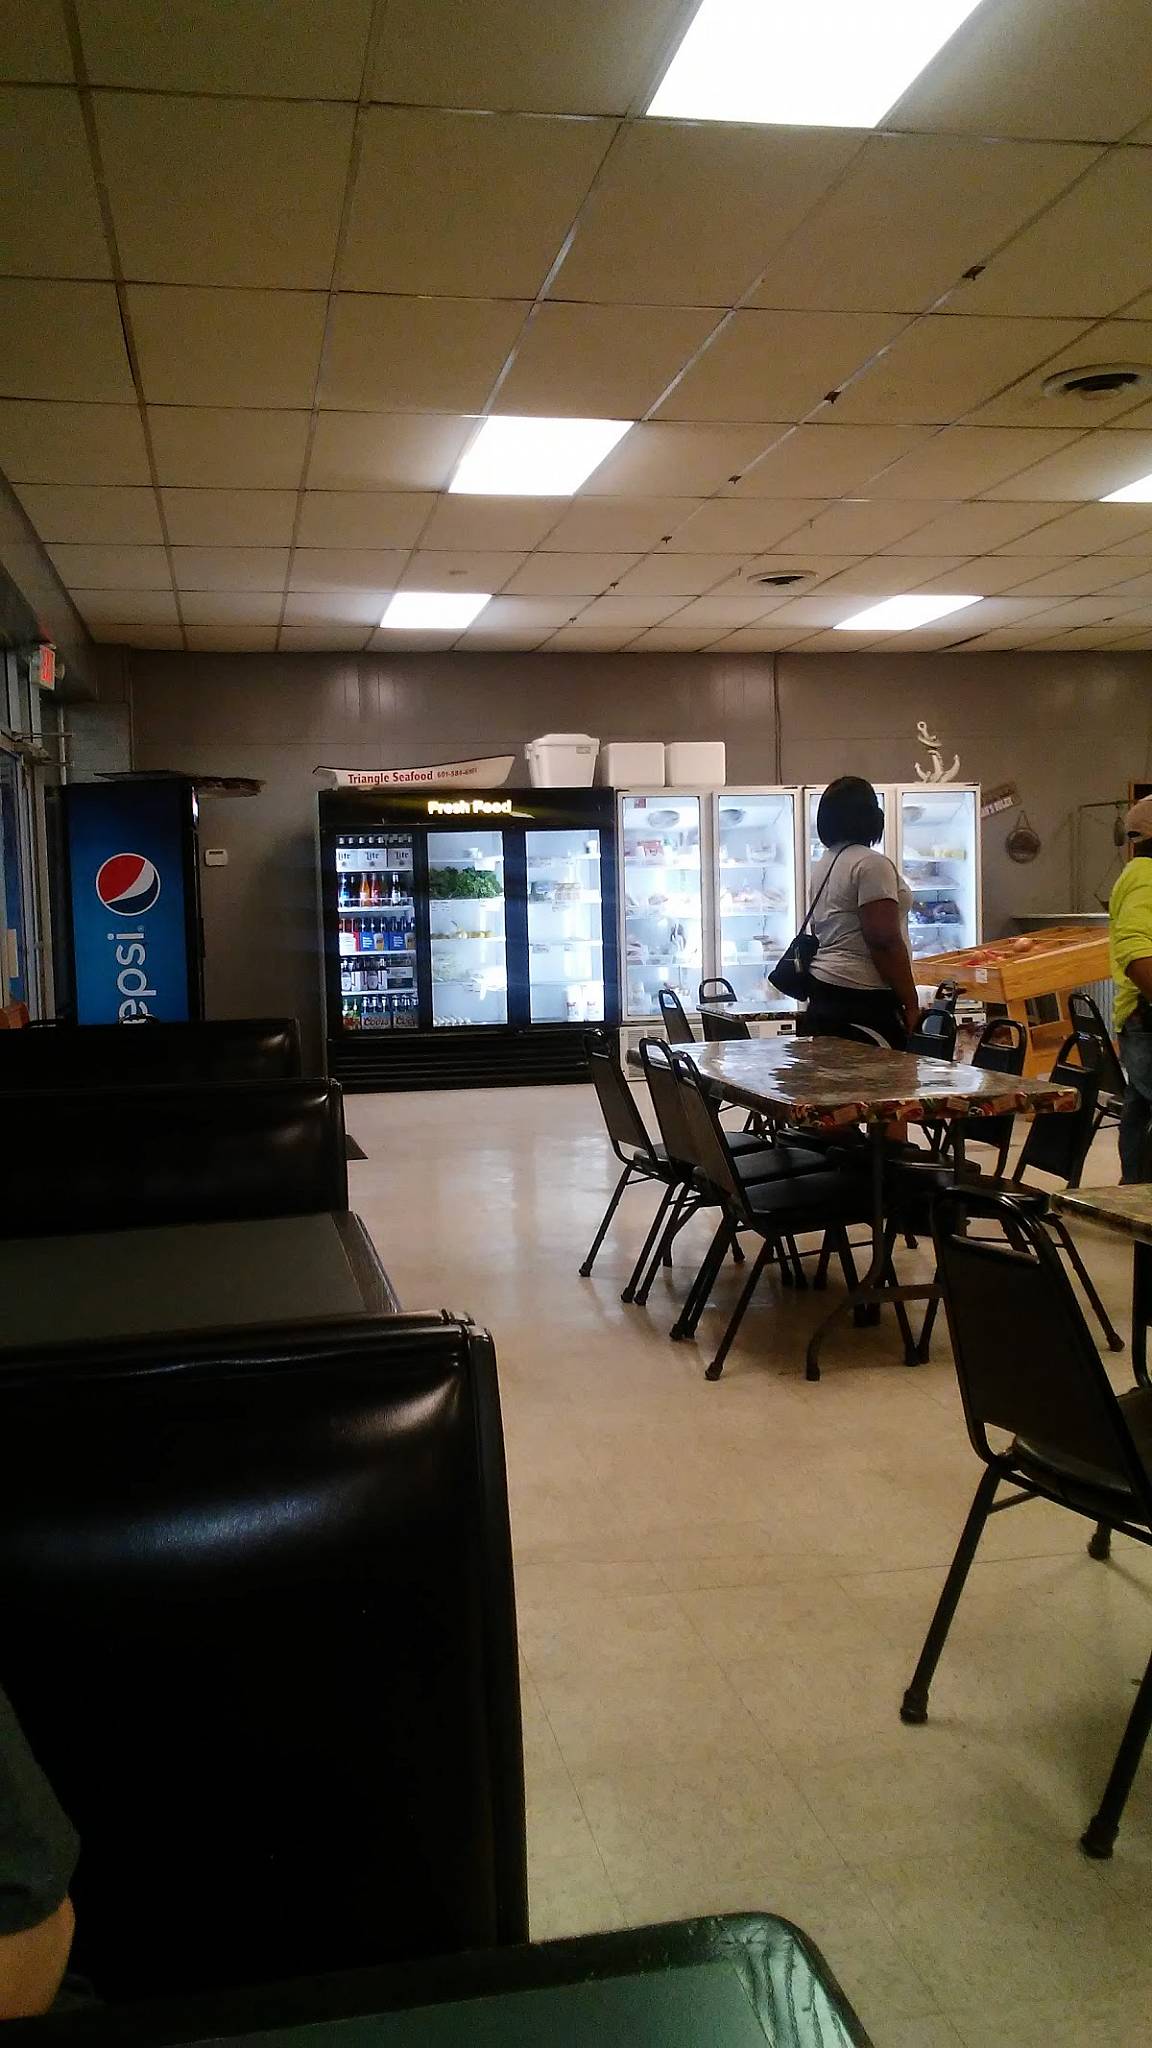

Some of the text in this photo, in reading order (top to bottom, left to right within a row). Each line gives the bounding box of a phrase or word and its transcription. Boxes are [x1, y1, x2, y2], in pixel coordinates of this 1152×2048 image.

[348, 774, 389, 785] Triangle
[392, 770, 433, 782] Seafood
[428, 799, 512, 815] Fresh Food
[107, 933, 156, 1016] epsi
